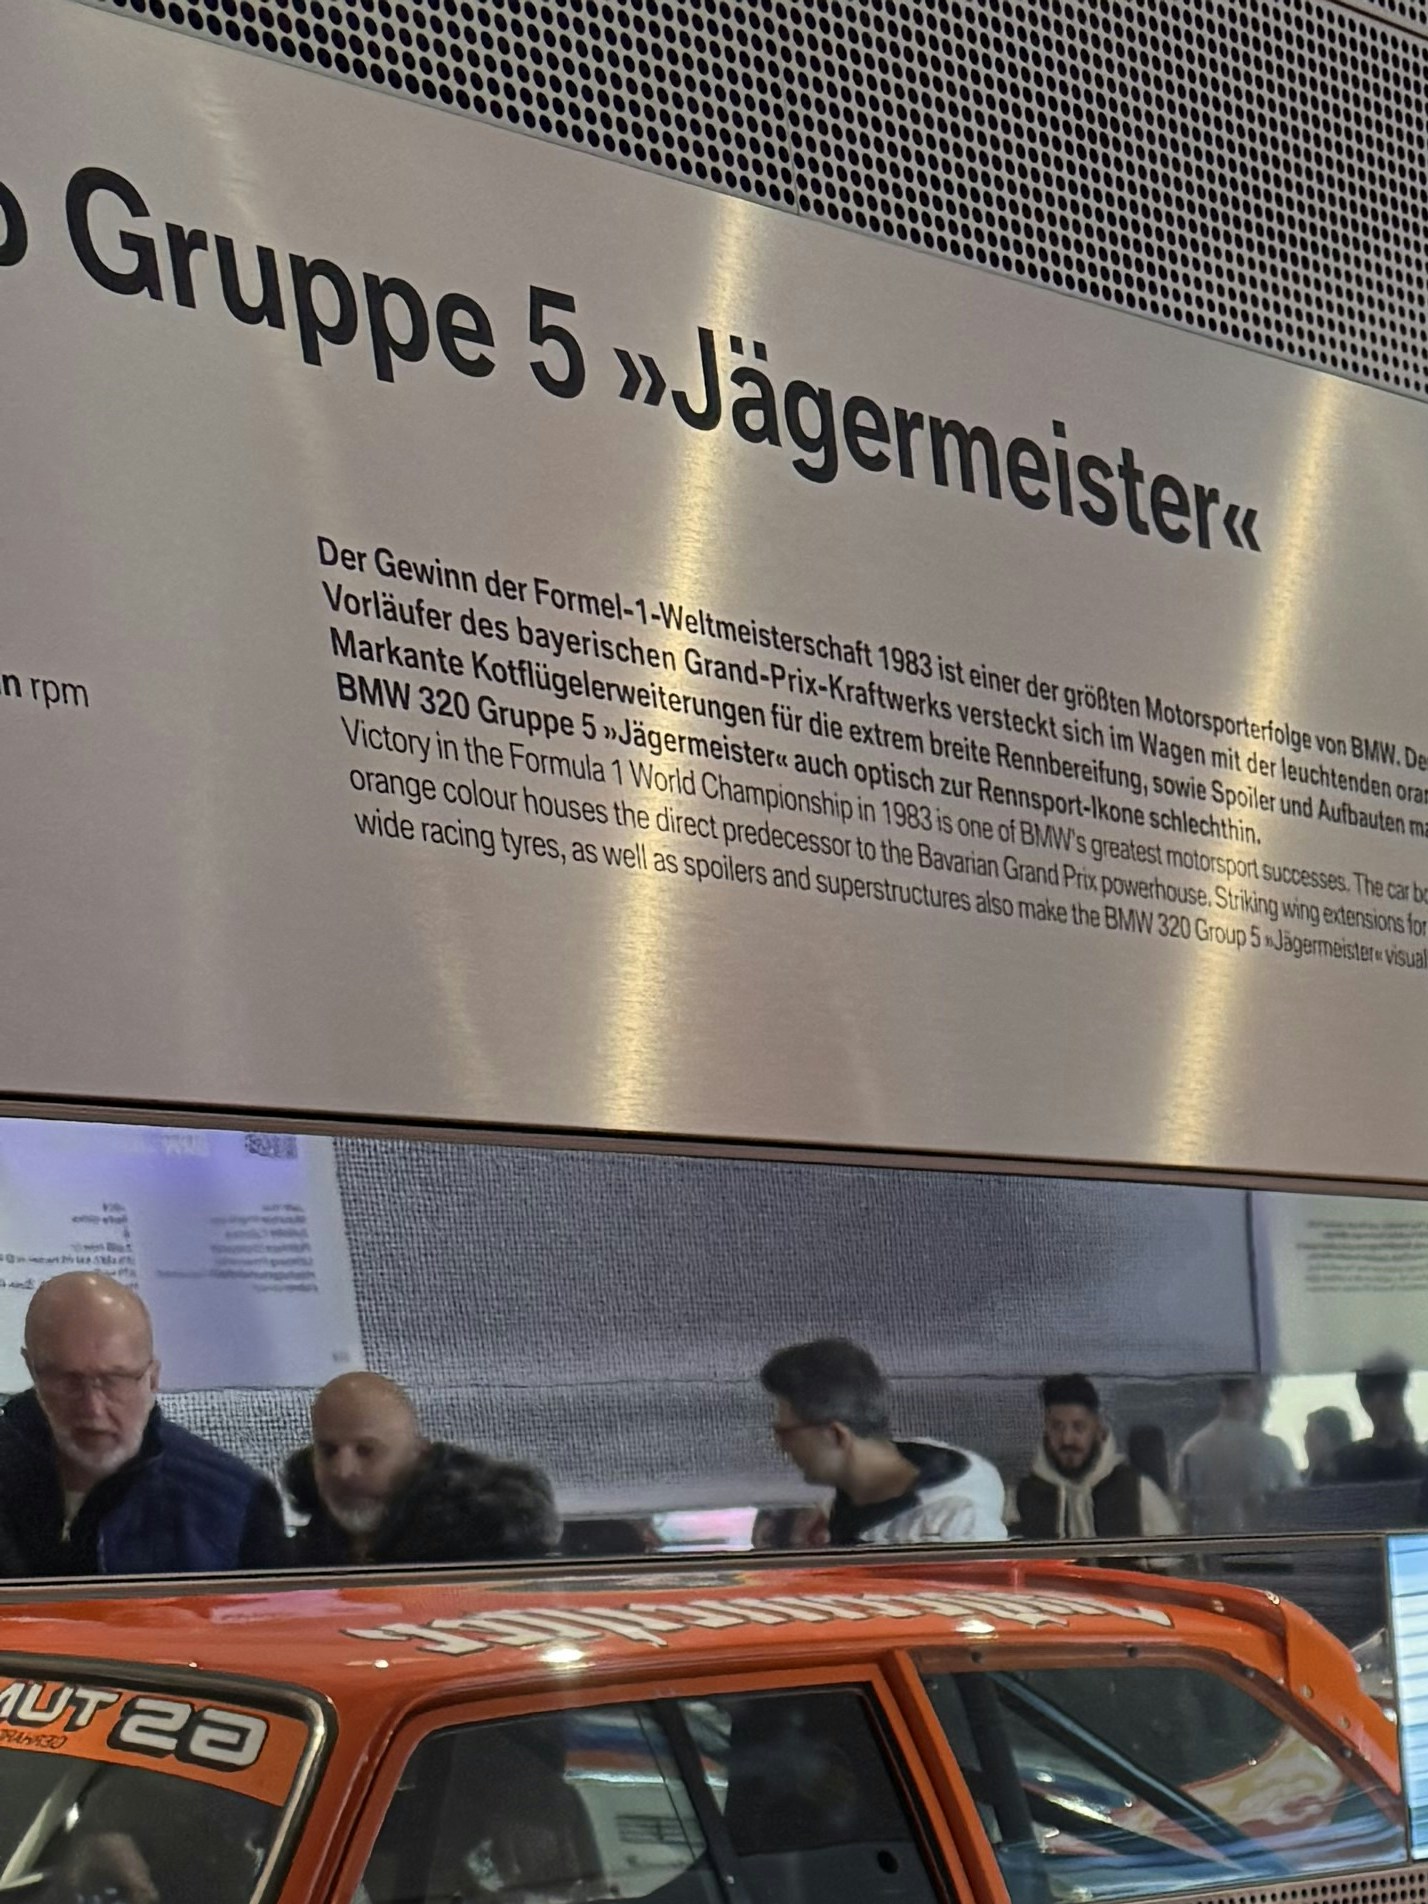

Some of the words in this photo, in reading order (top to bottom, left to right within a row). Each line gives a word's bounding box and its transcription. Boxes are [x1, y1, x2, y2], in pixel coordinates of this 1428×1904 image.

[66, 166, 496, 383] Gruppe
[529, 285, 586, 399] 5
[613, 325, 1262, 553] »Jägermeister«
[29, 677, 90, 710] rpm
[317, 535, 367, 573] Der
[374, 547, 478, 593] Gewinn
[484, 569, 528, 602] der
[533, 577, 873, 668] Formel-1-Weltmeisterschaft
[878, 645, 933, 679] 1983
[937, 655, 965, 685] ist
[969, 663, 1021, 695] einer
[1025, 673, 1059, 702] der
[1063, 684, 1141, 718] größten
[1144, 695, 1312, 752] Motorsporterfolge
[1314, 735, 1347, 756] von
[1350, 735, 1401, 766] BMW.
[321, 580, 453, 631] Vorläufer
[460, 607, 510, 642] des
[516, 615, 677, 671] bayerischen
[684, 647, 952, 720] Grand-Prix-Kraftwerks
[956, 703, 1058, 740] versteckt
[1062, 718, 1105, 747] sich
[1109, 724, 1134, 753] im
[1138, 730, 1206, 767] Wagen
[1210, 747, 1242, 772] mit
[1246, 751, 1277, 778] der
[1281, 756, 1392, 799] leuchtenden
[329, 626, 464, 676] Markante
[471, 650, 766, 728] Kotflügelerweiterungen
[770, 702, 803, 733] für
[809, 710, 843, 740] die
[849, 723, 924, 754] extrem
[929, 730, 991, 765] breite
[995, 742, 1148, 797] Rennbereifung,
[1152, 775, 1207, 801] sowie
[1211, 779, 1276, 812] Spoiler
[1279, 795, 1313, 819] und
[1317, 798, 1406, 835] Aufbauten
[336, 672, 411, 711] BMW
[418, 685, 470, 720] 320
[477, 695, 575, 740] Gruppe
[582, 712, 597, 740] 5
[794, 753, 848, 780] auch
[854, 762, 935, 794] optisch
[939, 776, 973, 800] zur
[977, 776, 1145, 826] Rennsport-Ikone
[1148, 808, 1261, 845] schlechthin.
[340, 715, 431, 764] Victory
[436, 733, 459, 762] in
[463, 736, 504, 768] the
[508, 741, 606, 783] Formula
[611, 758, 623, 786] 1
[628, 759, 696, 796] World
[701, 771, 853, 824] Championship
[857, 795, 876, 823] in
[881, 800, 933, 832] 1983
[936, 807, 954, 835] is
[957, 817, 994, 840] one
[997, 818, 1016, 844] of
[1019, 820, 1087, 854] BMW's
[1090, 838, 1163, 866] greatest
[1165, 848, 1260, 880] motorsport
[1261, 863, 1351, 892] successes.
[349, 769, 437, 805] orange
[442, 778, 518, 812] colour
[522, 785, 609, 825] houses
[613, 799, 650, 830] the
[656, 806, 719, 840] direct
[722, 820, 852, 857] predecessor
[856, 836, 876, 861] to
[880, 838, 913, 867] the
[917, 842, 1000, 878] Bavarian
[1003, 855, 1060, 886] Grand
[1062, 863, 1098, 892] Prix
[1100, 875, 1212, 907] powerhouse.
[1214, 885, 1279, 921] Striking
[1281, 897, 1321, 927] wing
[354, 810, 415, 840] wide
[421, 822, 496, 857] racing
[500, 827, 566, 865] tyres,
[572, 841, 599, 864] as
[602, 842, 648, 870] well
[653, 852, 679, 874] as
[683, 854, 768, 886] spoilers
[772, 865, 811, 891] and
[975, 889, 1014, 917] also
[1017, 898, 1068, 924] make
[1071, 902, 1101, 928] the
[1104, 904, 1154, 935] BMW
[1157, 912, 1192, 940] 320
[1194, 917, 1247, 951] Group
[1250, 924, 1261, 948] 5
